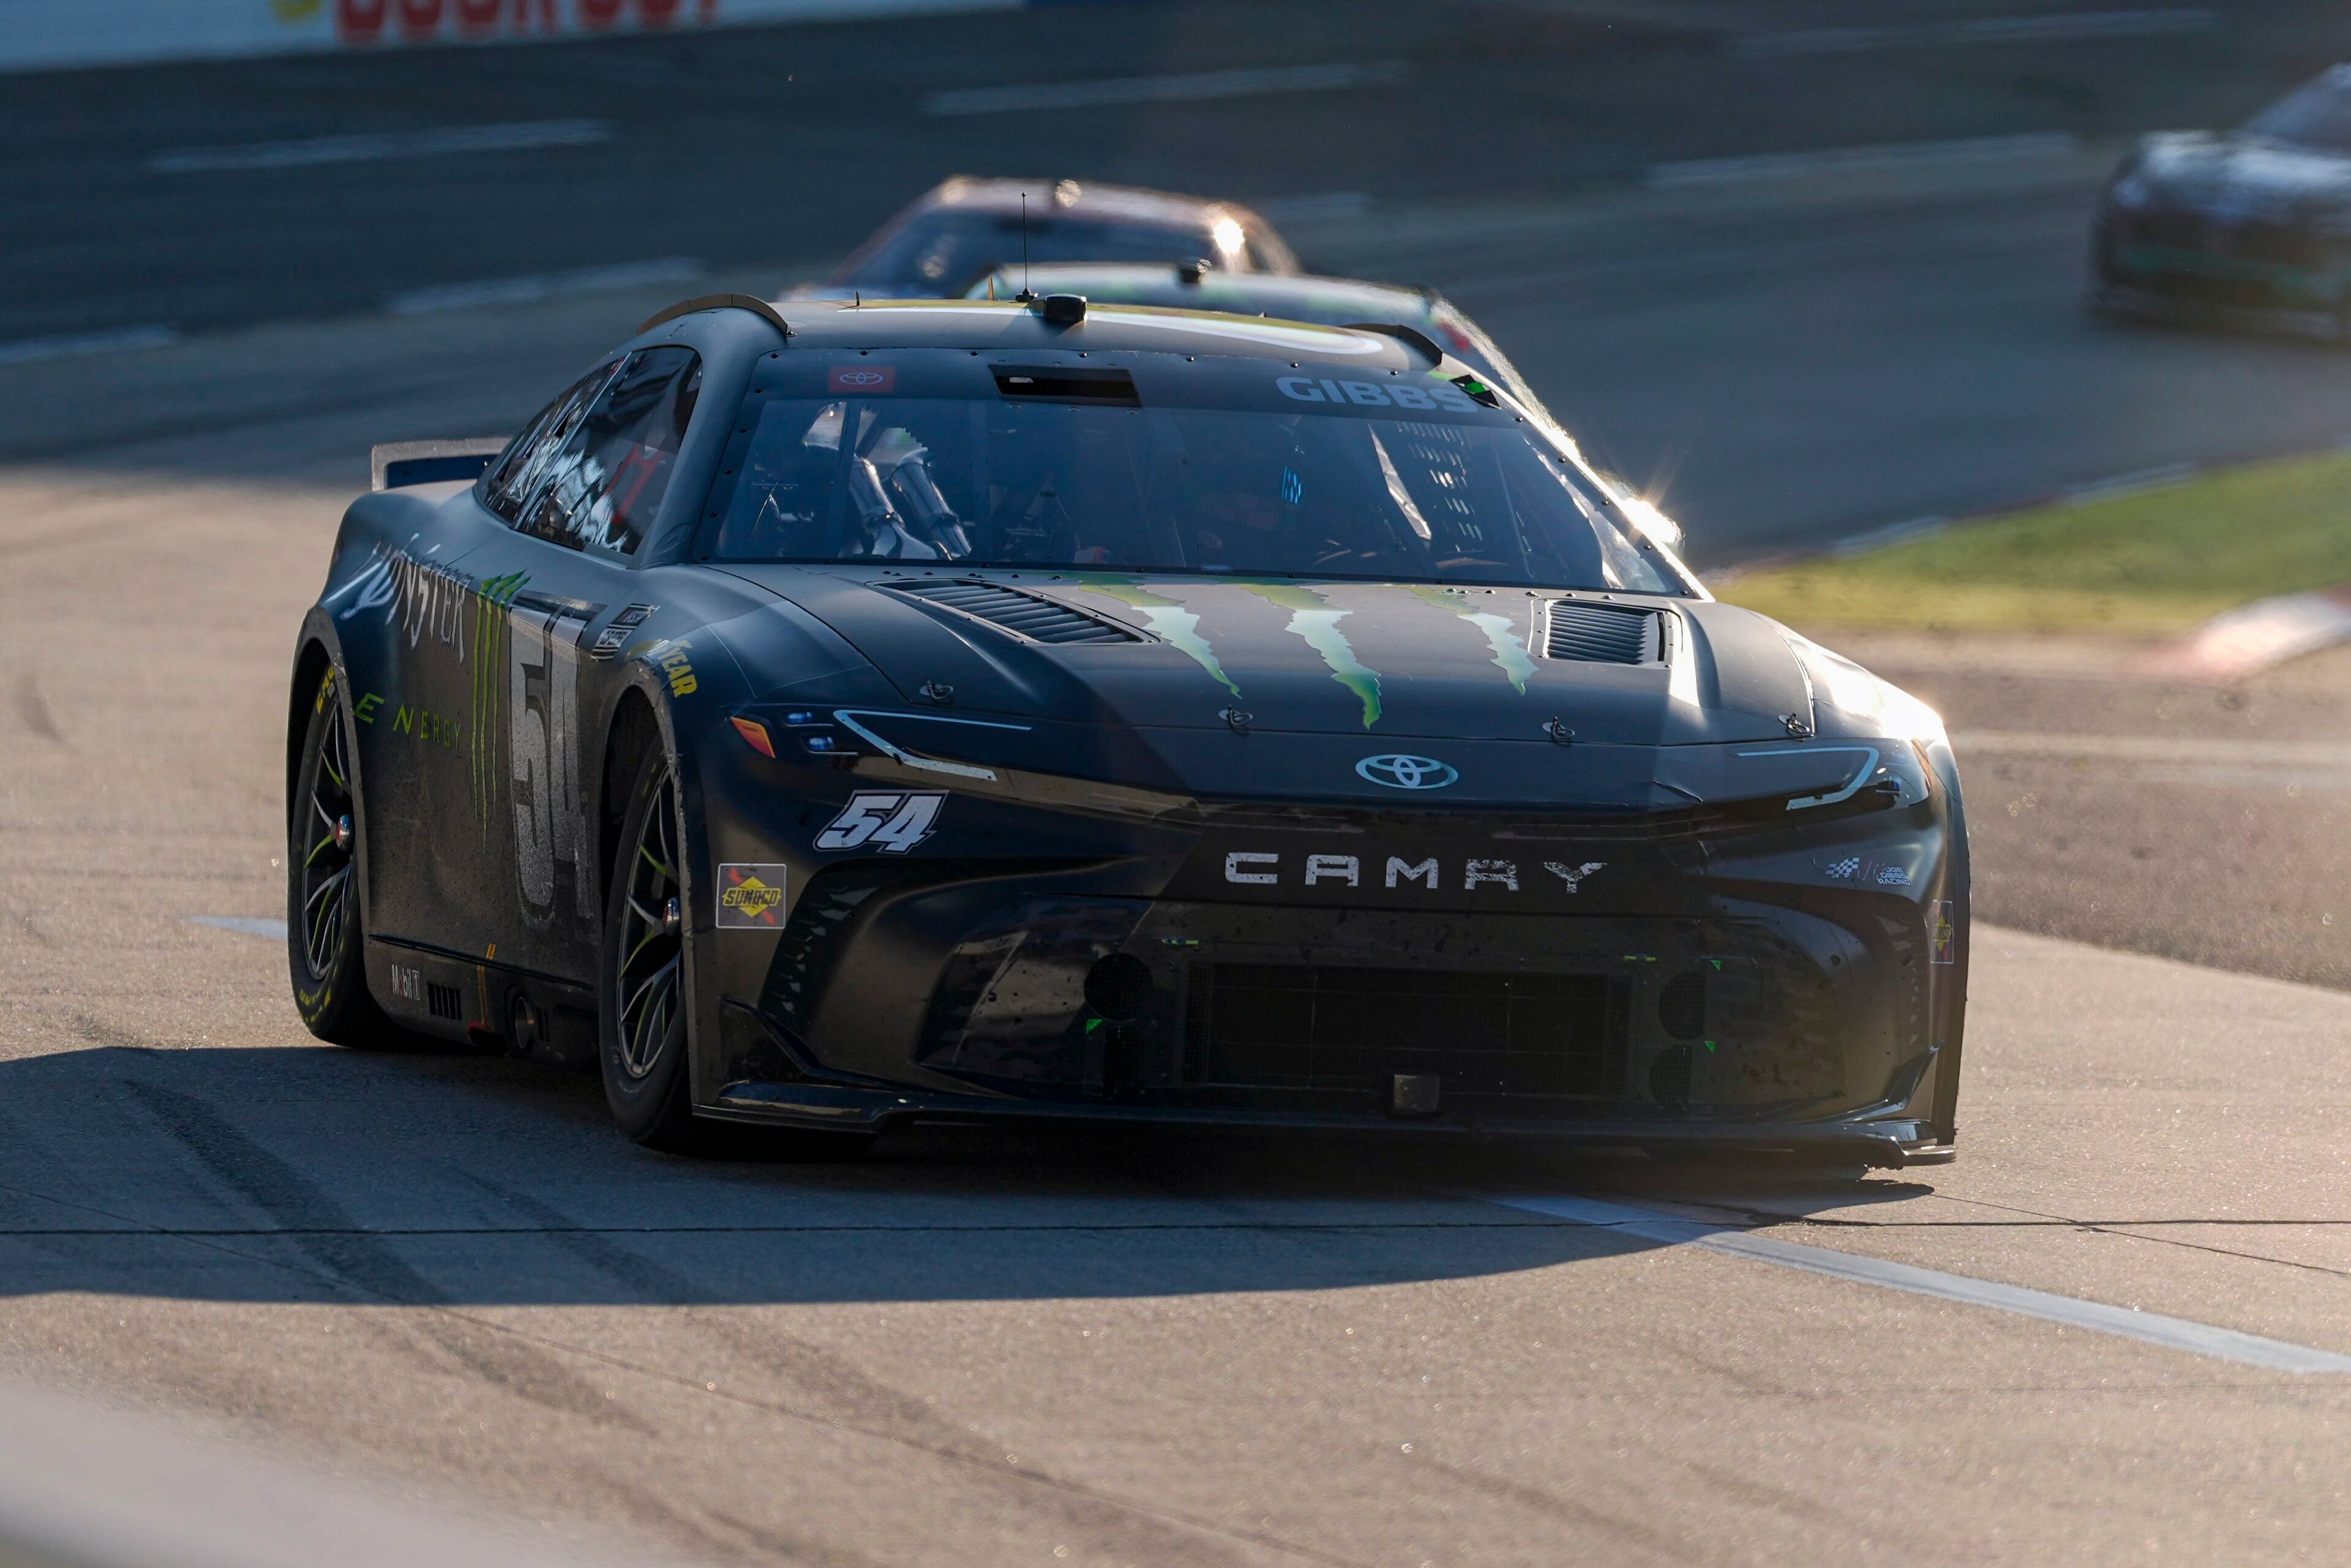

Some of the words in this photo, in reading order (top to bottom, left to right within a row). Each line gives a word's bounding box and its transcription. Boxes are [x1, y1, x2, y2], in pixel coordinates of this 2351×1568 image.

[1276, 377, 1478, 413] GIBBS
[353, 692, 461, 752] ENERGY
[812, 790, 950, 855] 54
[1225, 852, 1608, 893] CAMRY
[723, 888, 781, 906] SUNOCO
